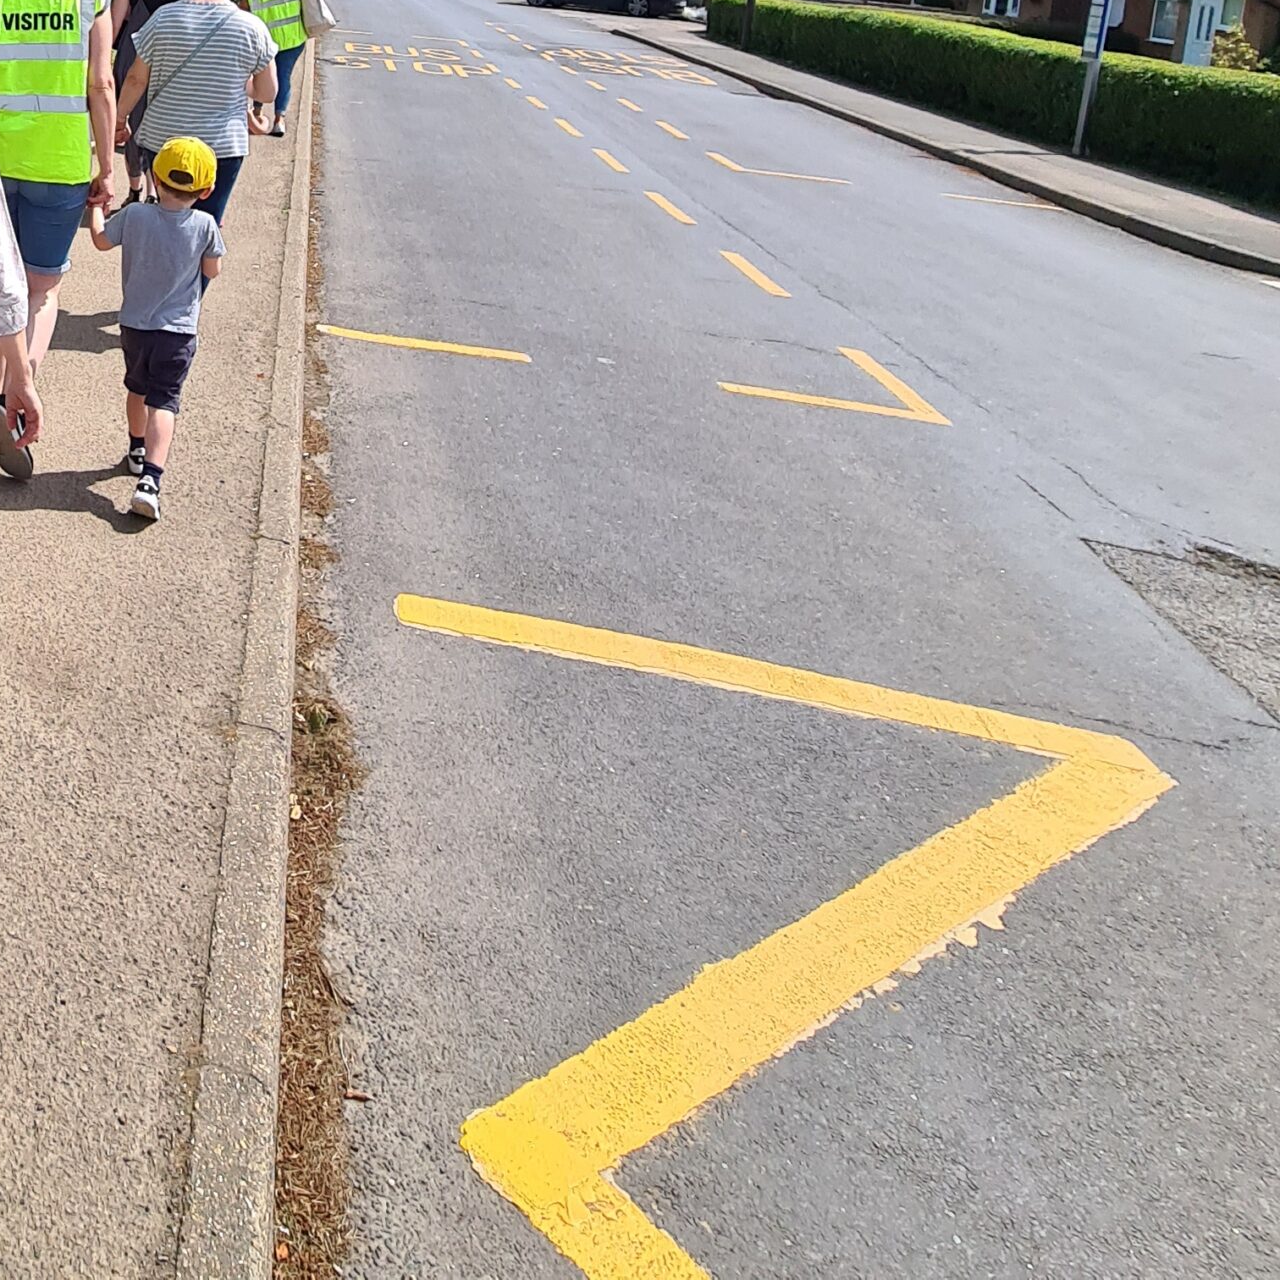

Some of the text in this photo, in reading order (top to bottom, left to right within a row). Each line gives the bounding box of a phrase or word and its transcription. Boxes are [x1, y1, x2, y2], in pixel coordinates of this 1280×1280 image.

[2, 12, 74, 31] VISITOR
[344, 42, 461, 61] BUS
[333, 55, 495, 78] STOP
[578, 60, 718, 86] BUS
